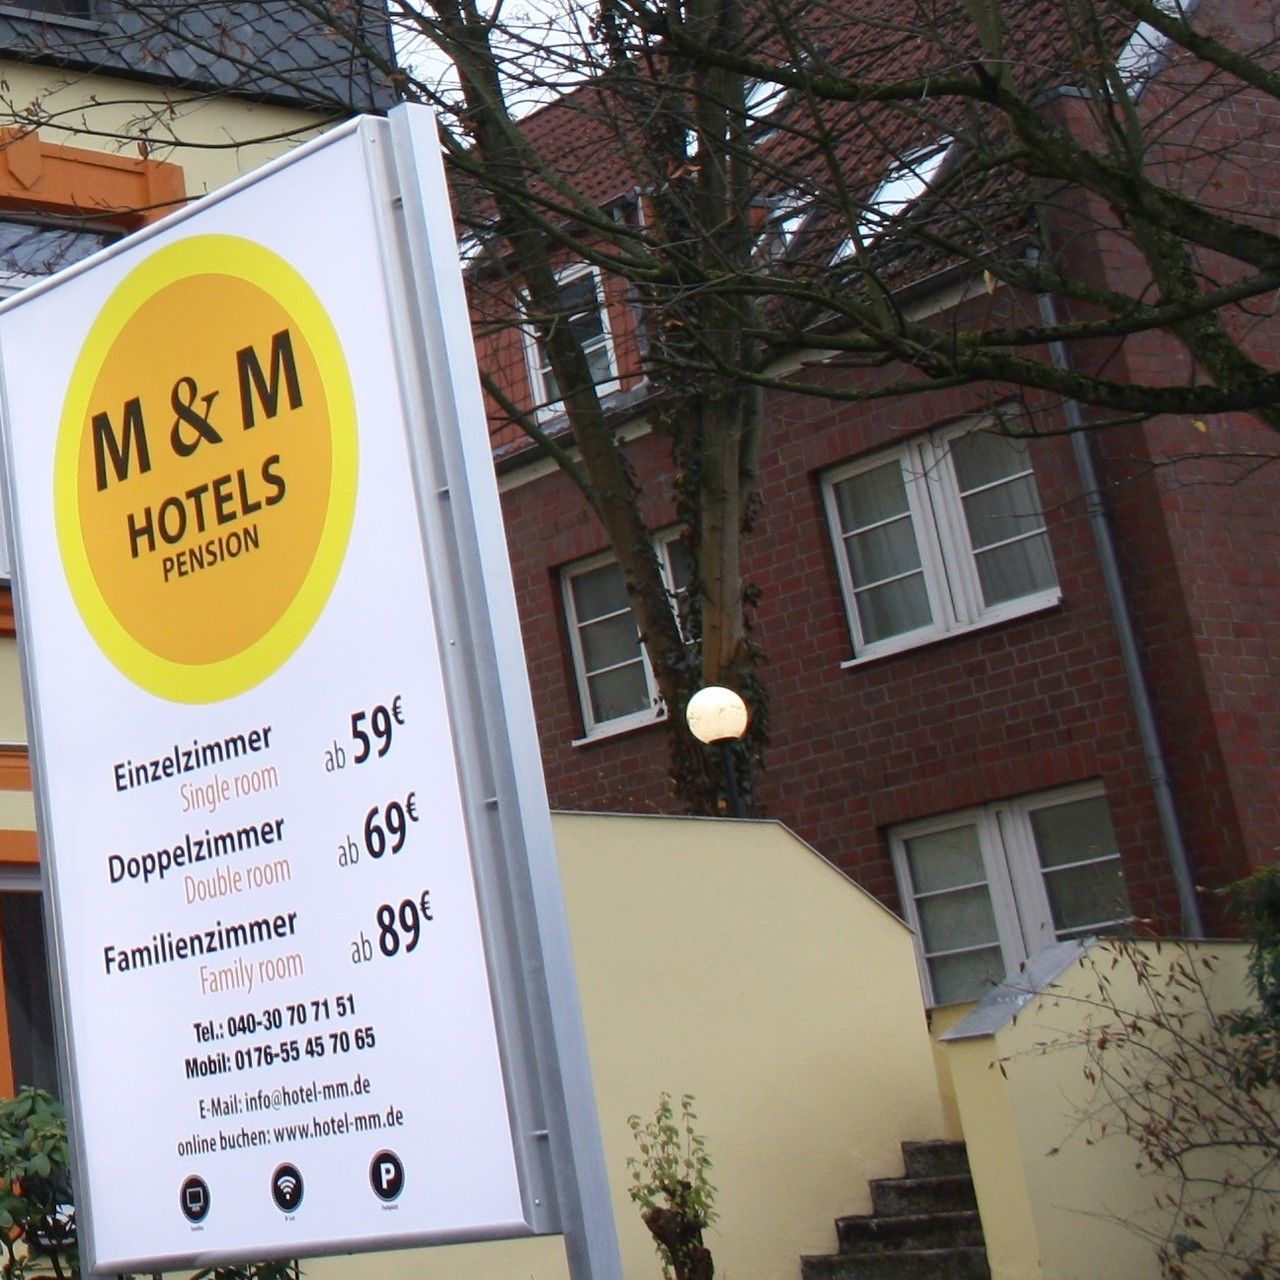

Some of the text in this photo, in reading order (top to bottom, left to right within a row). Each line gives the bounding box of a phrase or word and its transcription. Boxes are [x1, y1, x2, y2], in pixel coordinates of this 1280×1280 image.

[91, 328, 303, 492] M & M
[127, 455, 287, 559] HOTELS
[162, 523, 260, 582] PENSION
[114, 723, 273, 793] Einzelzimmer
[325, 740, 346, 773] ab
[181, 764, 278, 814] Single room
[108, 815, 285, 884] Doppelzimmer
[338, 836, 359, 868] ab
[184, 856, 291, 905] Double room
[103, 909, 297, 975] Familienzimmer
[350, 932, 373, 965] ab
[200, 951, 304, 996] Family room
[193, 993, 355, 1043] Tel.: 040-30 70 71 51
[185, 1026, 376, 1079] Mobil: 0176-55 45 70 65
[199, 1073, 371, 1120] E-Mail: info@hotel-mm.de
[177, 1105, 404, 1156] online buchen: www.hotel-mm.de
[380, 1162, 395, 1189] P
